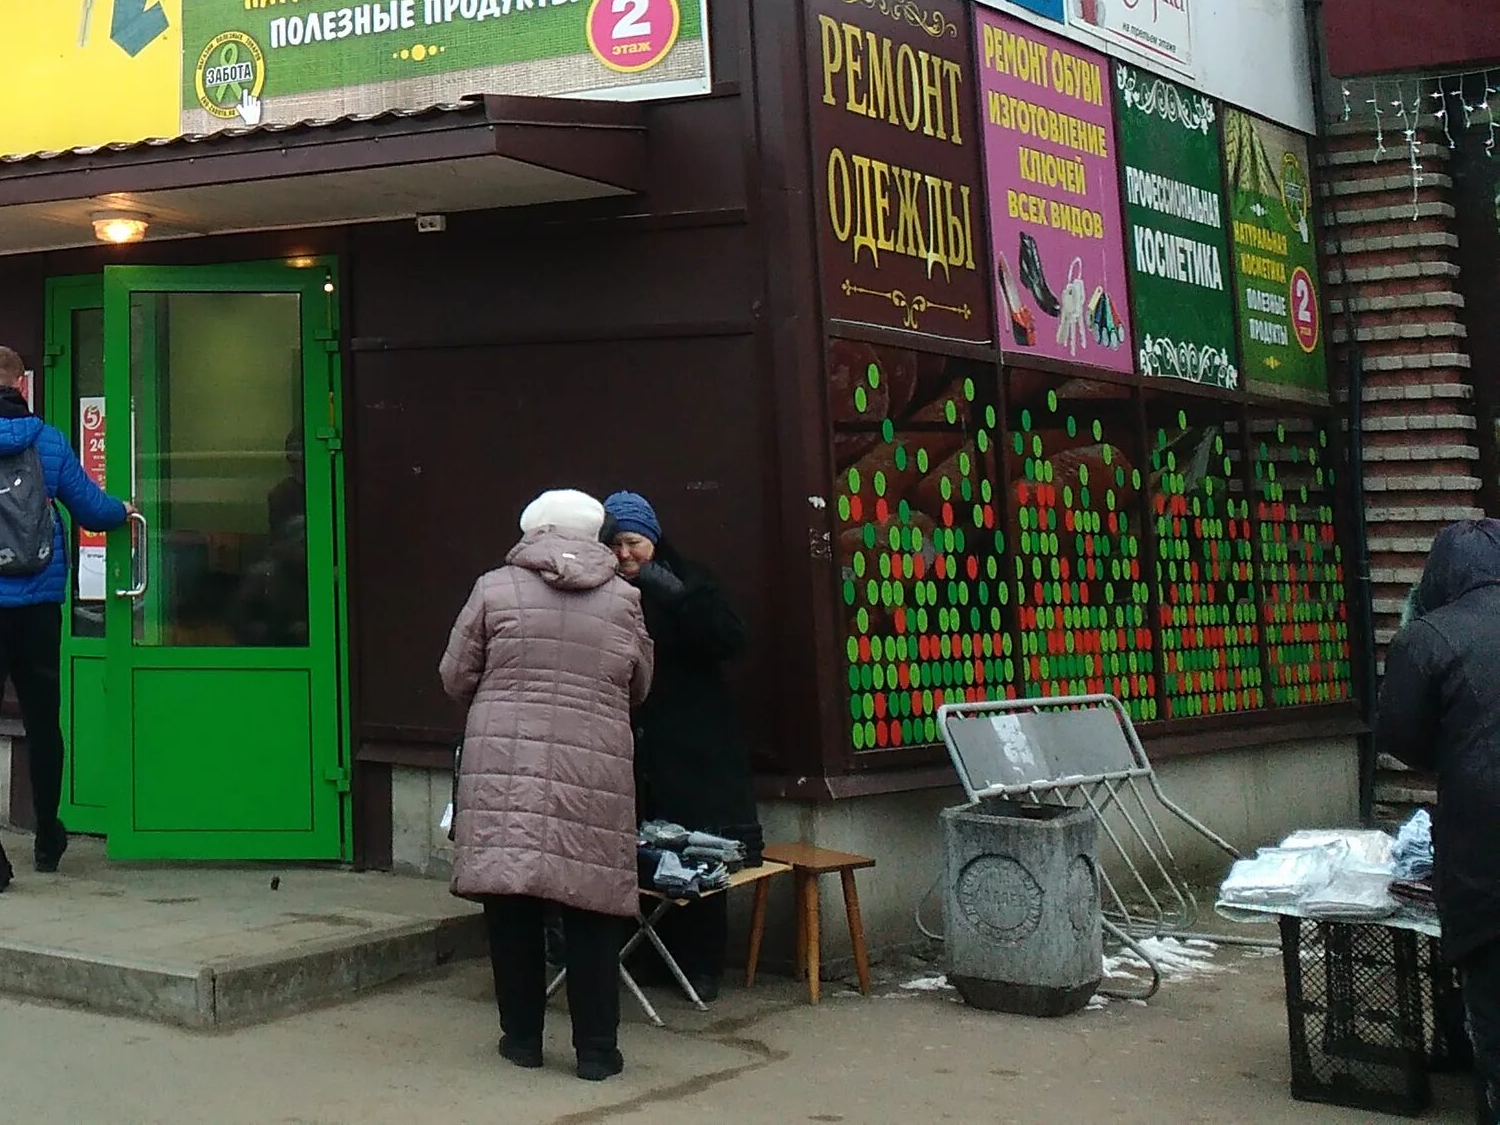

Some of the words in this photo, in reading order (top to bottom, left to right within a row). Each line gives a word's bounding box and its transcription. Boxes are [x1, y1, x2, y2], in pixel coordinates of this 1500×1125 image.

[270, 0, 416, 48] ПОЛЕЗНЫЕ
[612, 41, 652, 55] этаж
[208, 64, 251, 84] ЗАБОТА
[819, 14, 963, 145] РЕМОНТ
[983, 23, 1048, 88] РЕМОНТ
[1051, 49, 1103, 106] ОБУВИ
[988, 90, 1108, 158] ИЗГОТОВЛЕНИЕ
[1018, 146, 1086, 195] КЛЮЧЕЙ
[827, 147, 976, 283] ОДЕЖДЫ
[1007, 189, 1049, 226] ВСЕХ
[1050, 198, 1104, 240] ВИДОВ
[1125, 165, 1221, 229] ПРОФЕССИОНАЛЬНАЯ
[1133, 224, 1224, 291] КОСМЕТИКА
[1233, 220, 1288, 256] НАТУРАЛЬНАЯ
[1240, 252, 1287, 283] КОСМЕТИКА
[1246, 288, 1287, 316] ПОЛЕЗНЫЕ
[1296, 279, 1311, 323] 2
[1249, 318, 1289, 346] ПРОДУКТЫ
